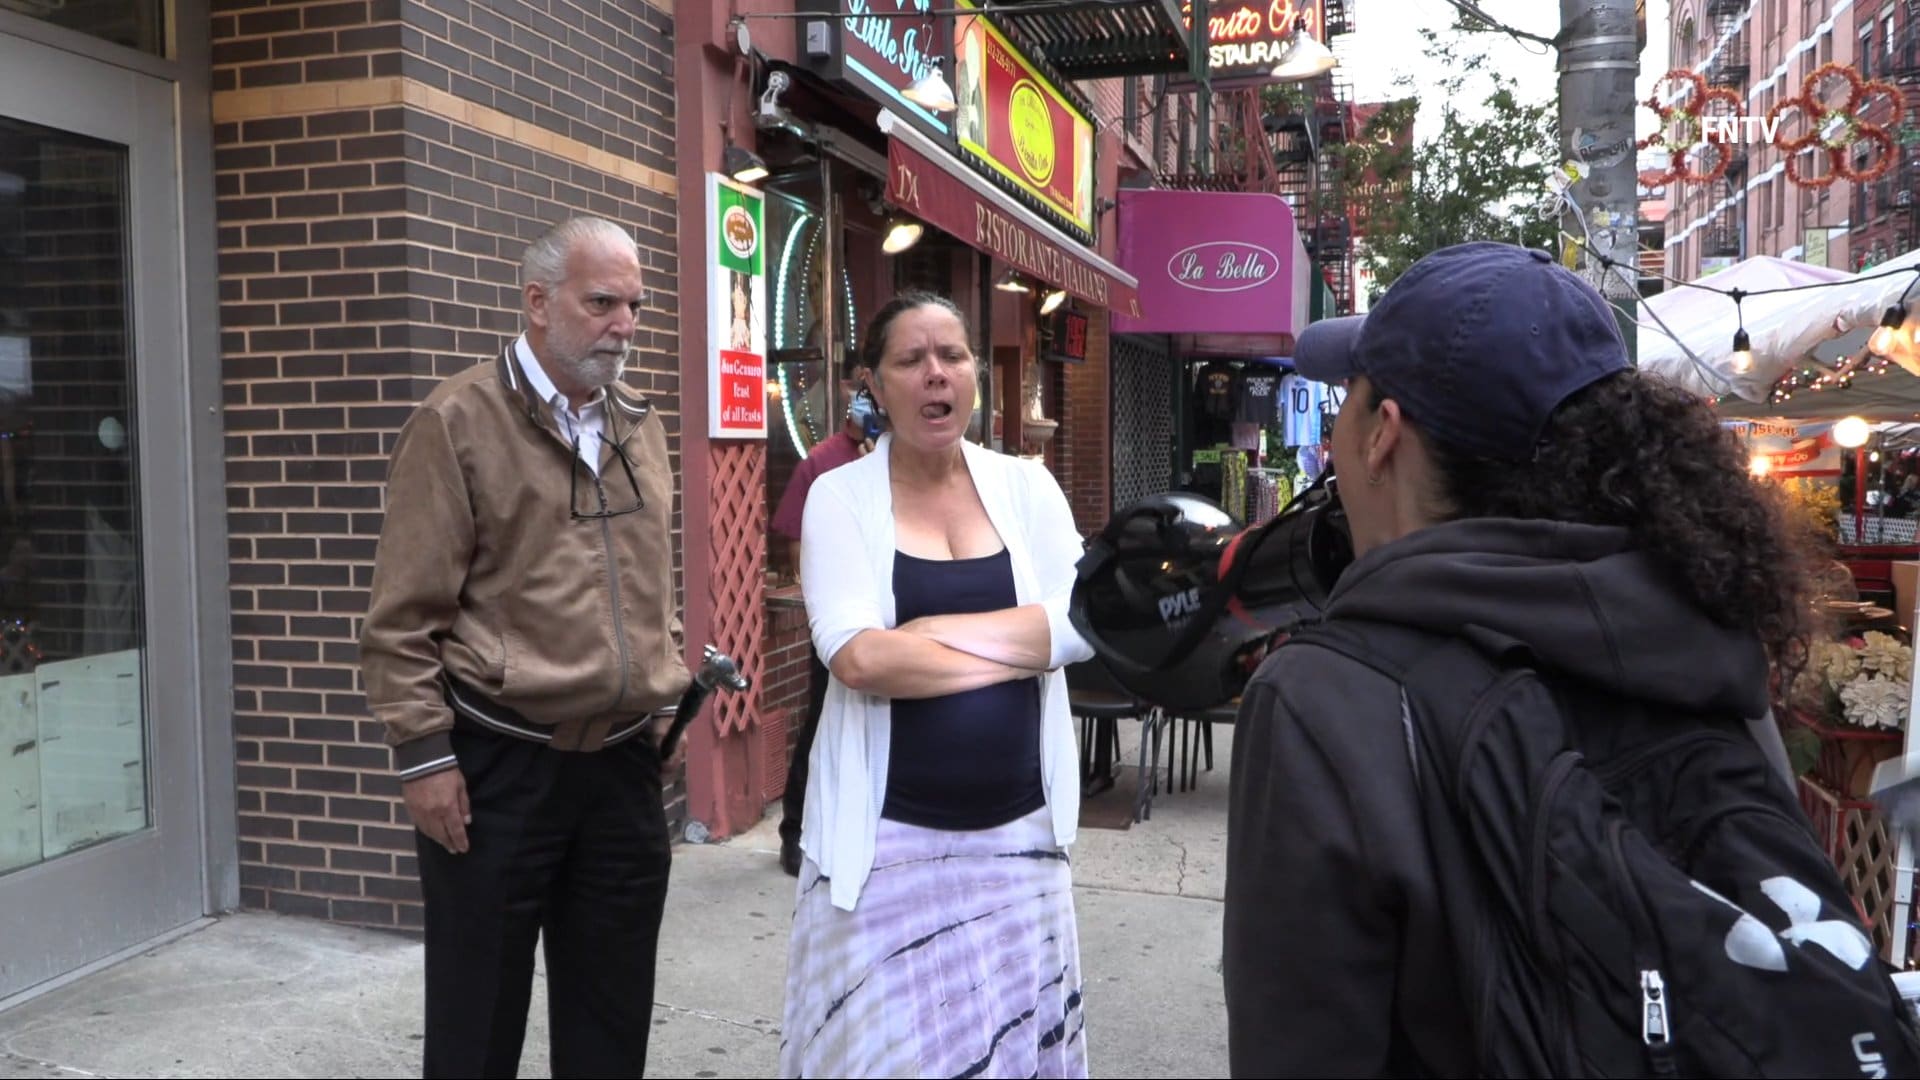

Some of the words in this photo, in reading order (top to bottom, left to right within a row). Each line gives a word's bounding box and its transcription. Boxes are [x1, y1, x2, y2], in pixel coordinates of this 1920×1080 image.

[845, 0, 898, 65] Little
[975, 201, 1061, 283] RISTORANTE
[1178, 252, 1204, 281] La
[1215, 252, 1266, 280] Bella
[1291, 387, 1310, 415] 10
[1158, 587, 1201, 621] PYLE
